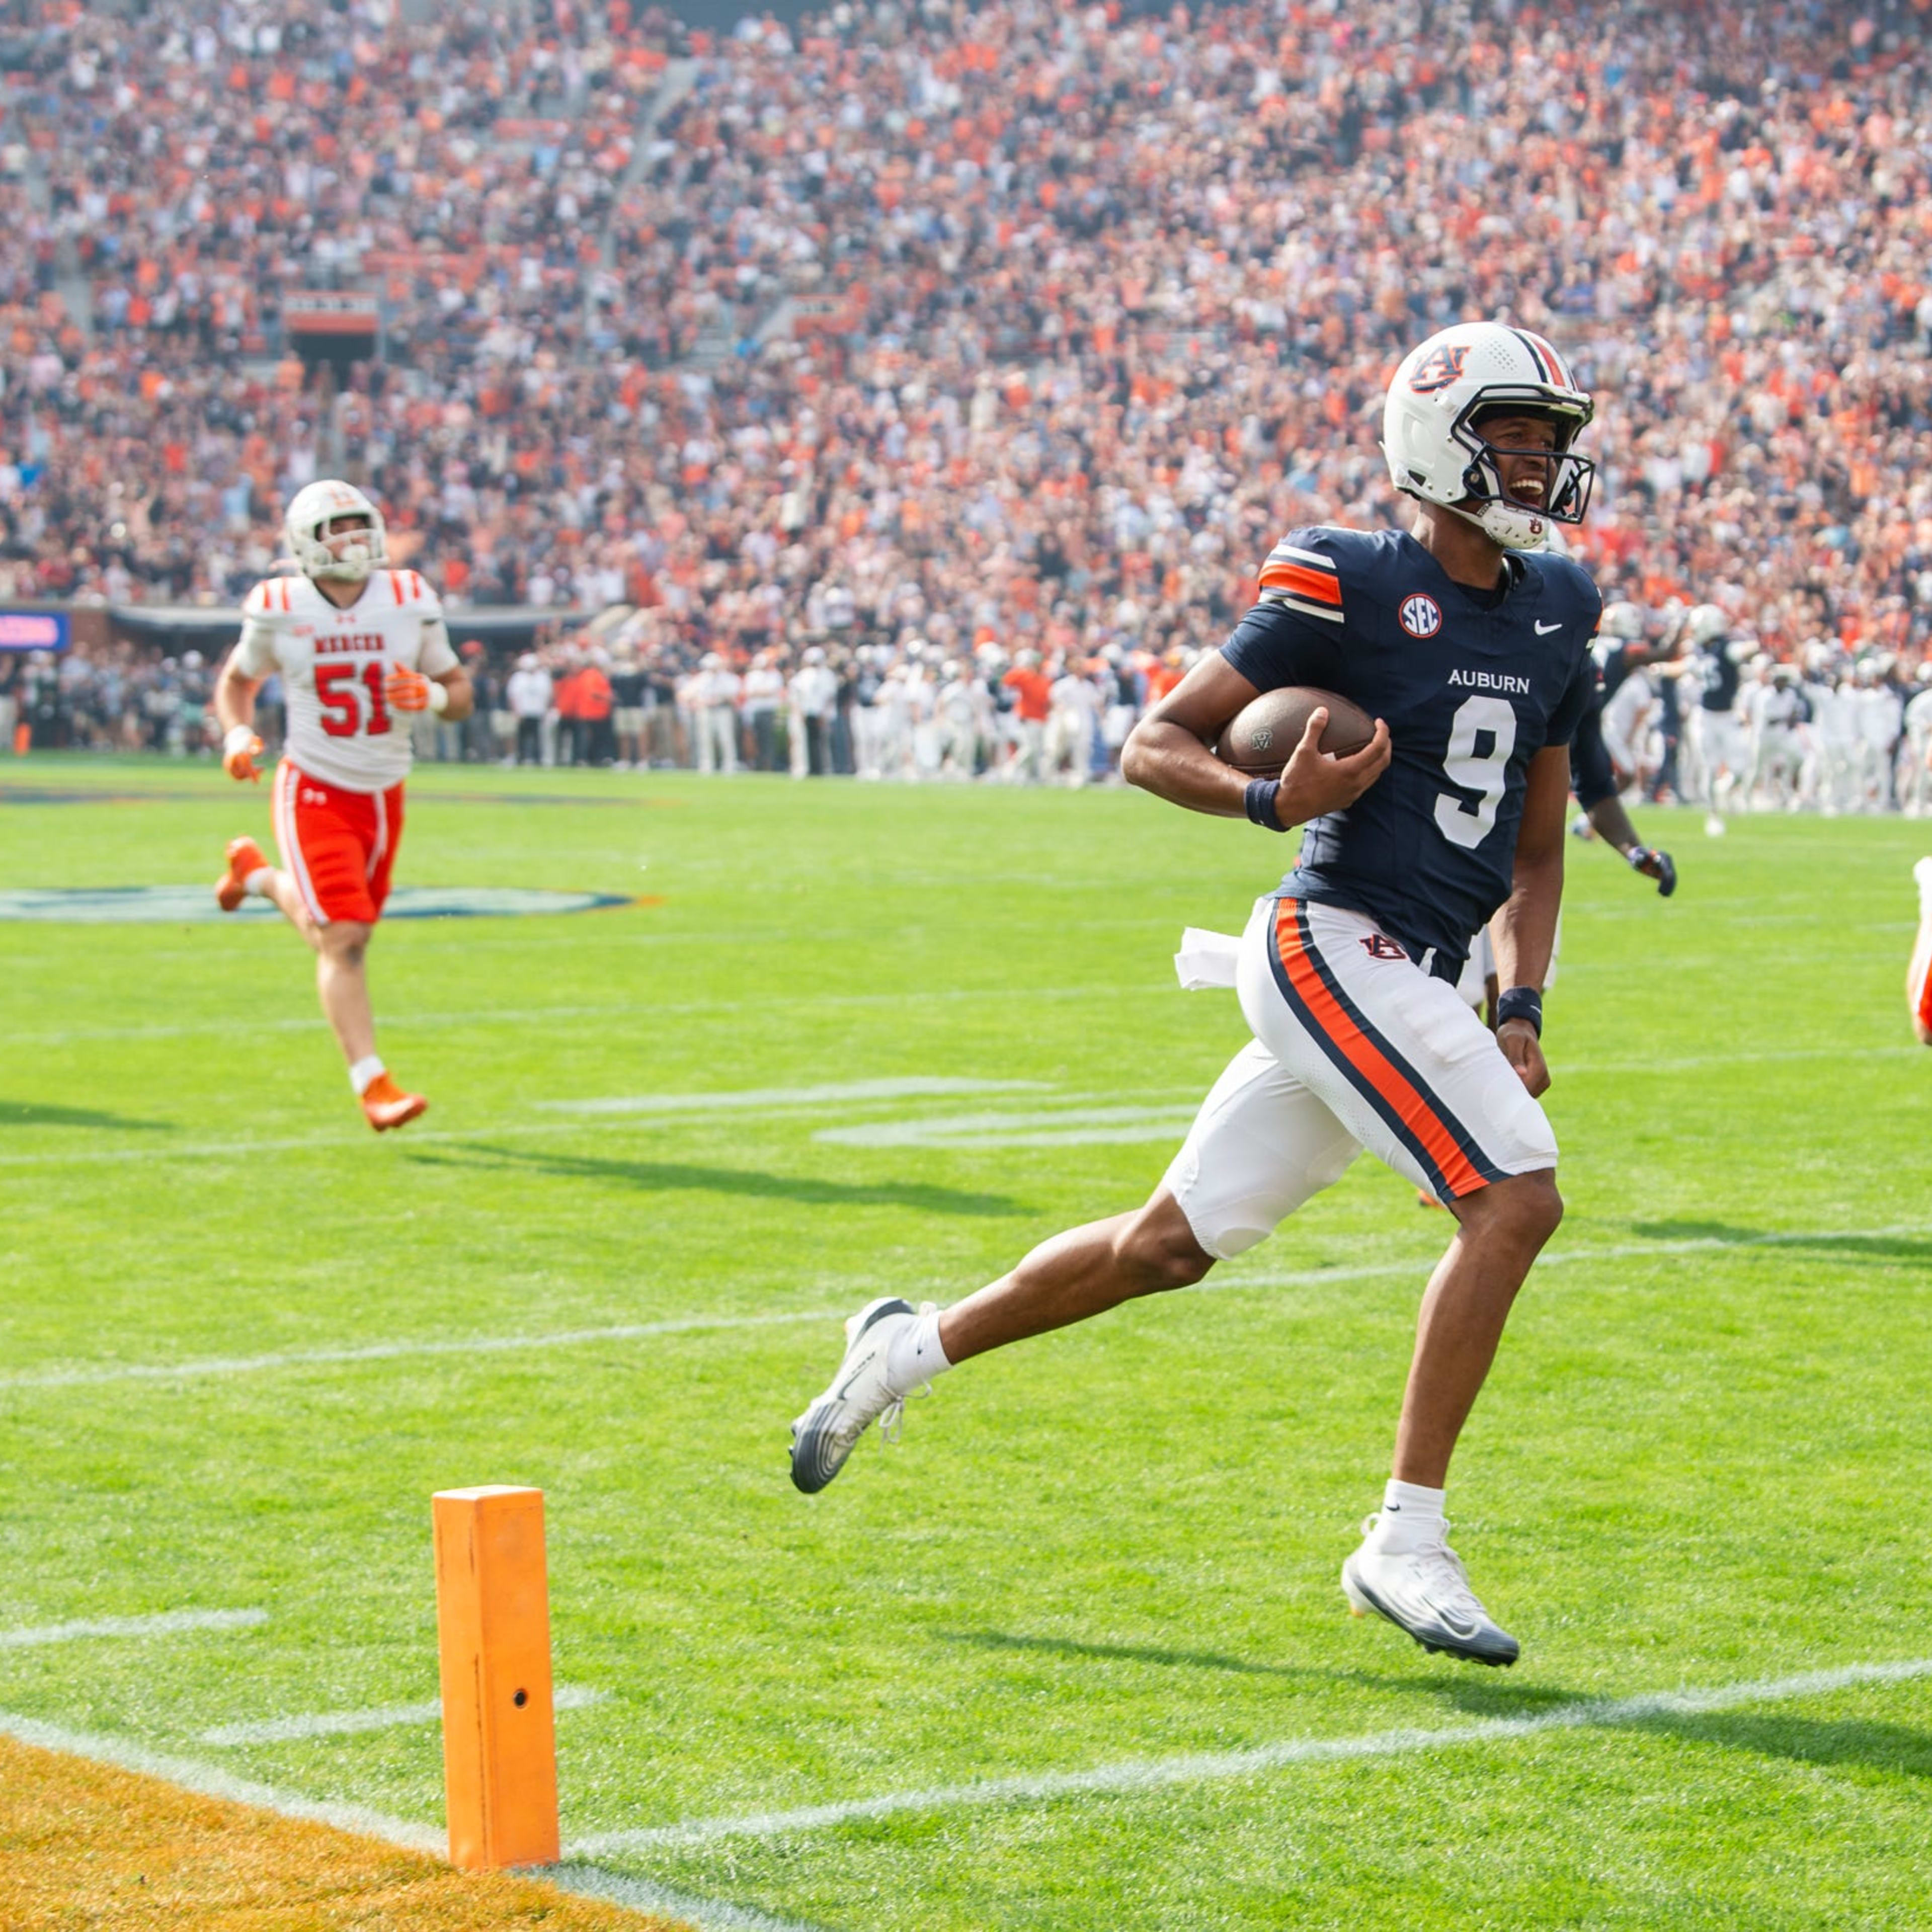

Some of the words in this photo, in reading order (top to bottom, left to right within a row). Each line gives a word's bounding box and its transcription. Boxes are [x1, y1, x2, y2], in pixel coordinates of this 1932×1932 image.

[1402, 597, 1439, 634] SEC
[314, 661, 392, 738] 51
[1447, 669, 1530, 694] AUBURN
[1434, 695, 1517, 849] 9
